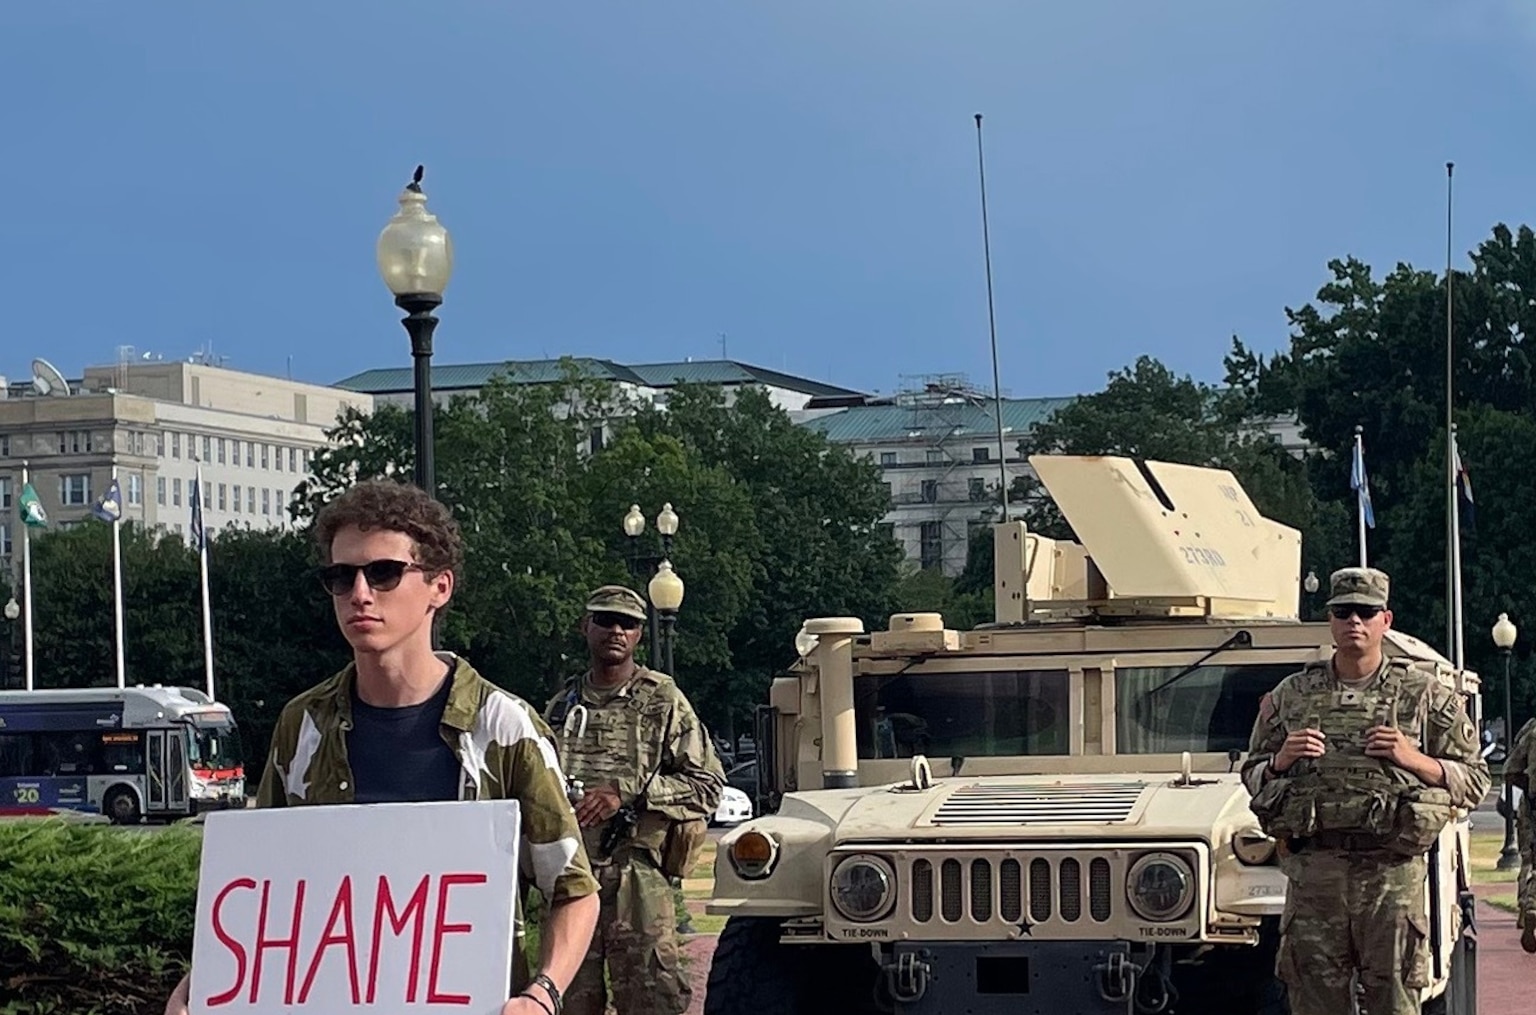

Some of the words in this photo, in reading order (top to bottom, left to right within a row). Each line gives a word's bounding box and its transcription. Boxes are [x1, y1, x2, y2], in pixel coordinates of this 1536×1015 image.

[1235, 510, 1255, 527] 21
[1179, 546, 1226, 567] 273RD
[206, 874, 487, 1006] SHAME
[841, 928, 888, 938] TIE-DOWN
[1139, 927, 1186, 937] TIE-DOWN
